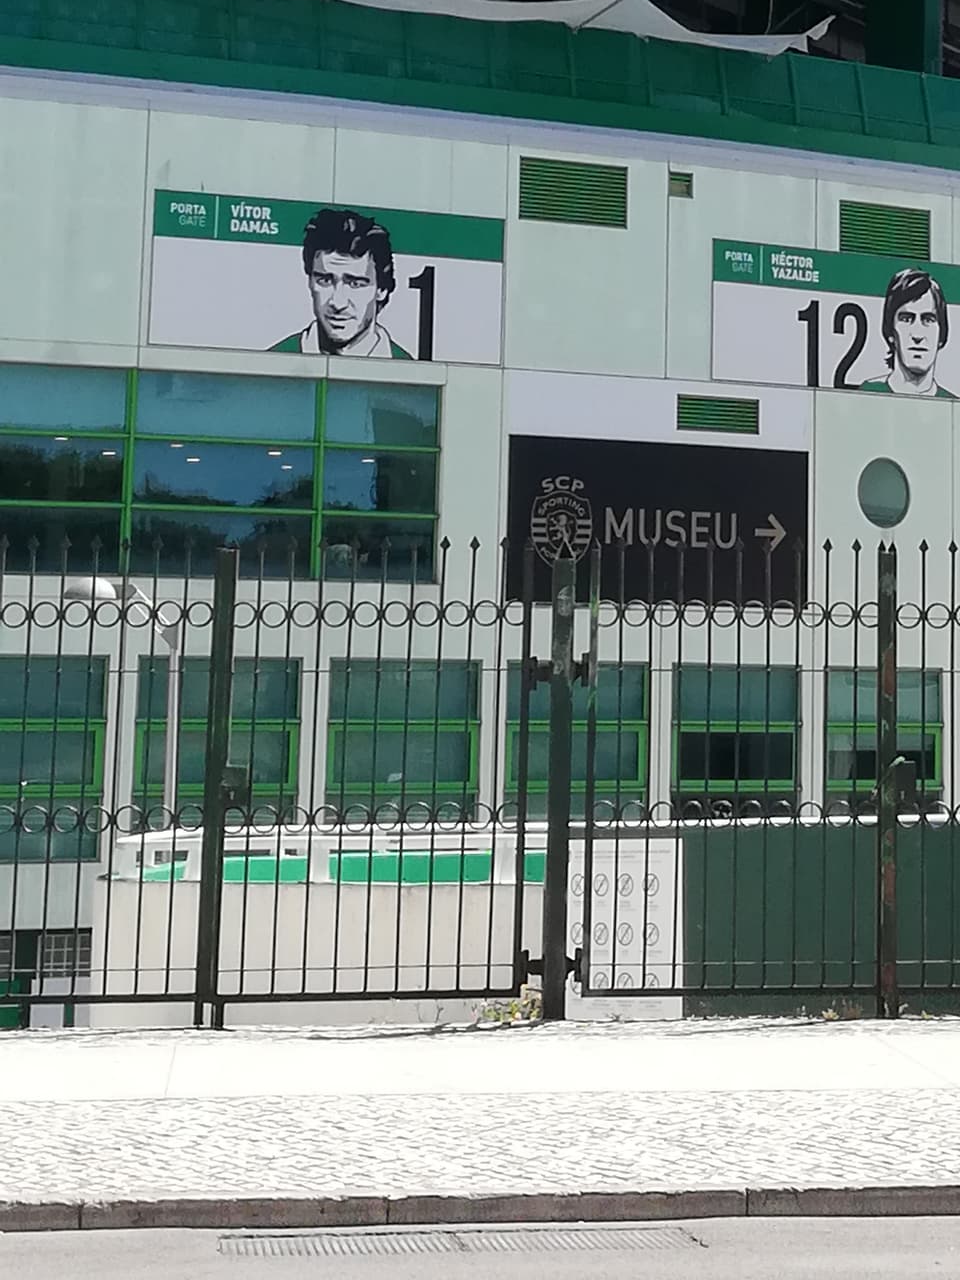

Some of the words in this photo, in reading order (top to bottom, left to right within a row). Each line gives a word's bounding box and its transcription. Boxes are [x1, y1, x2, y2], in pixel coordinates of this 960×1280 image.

[170, 202, 207, 216] PORTA
[230, 201, 272, 220] VÍTOR
[178, 214, 206, 227] GATE
[230, 219, 279, 235] DAMAS
[724, 251, 754, 263] PORTA
[770, 250, 814, 269] HÉCTOR
[771, 267, 820, 283] YAZALDE
[408, 265, 436, 362] 1
[797, 299, 868, 390] 12
[541, 475, 585, 493] SCP
[537, 496, 586, 517] SPORTING
[604, 506, 737, 550] MUSEU
